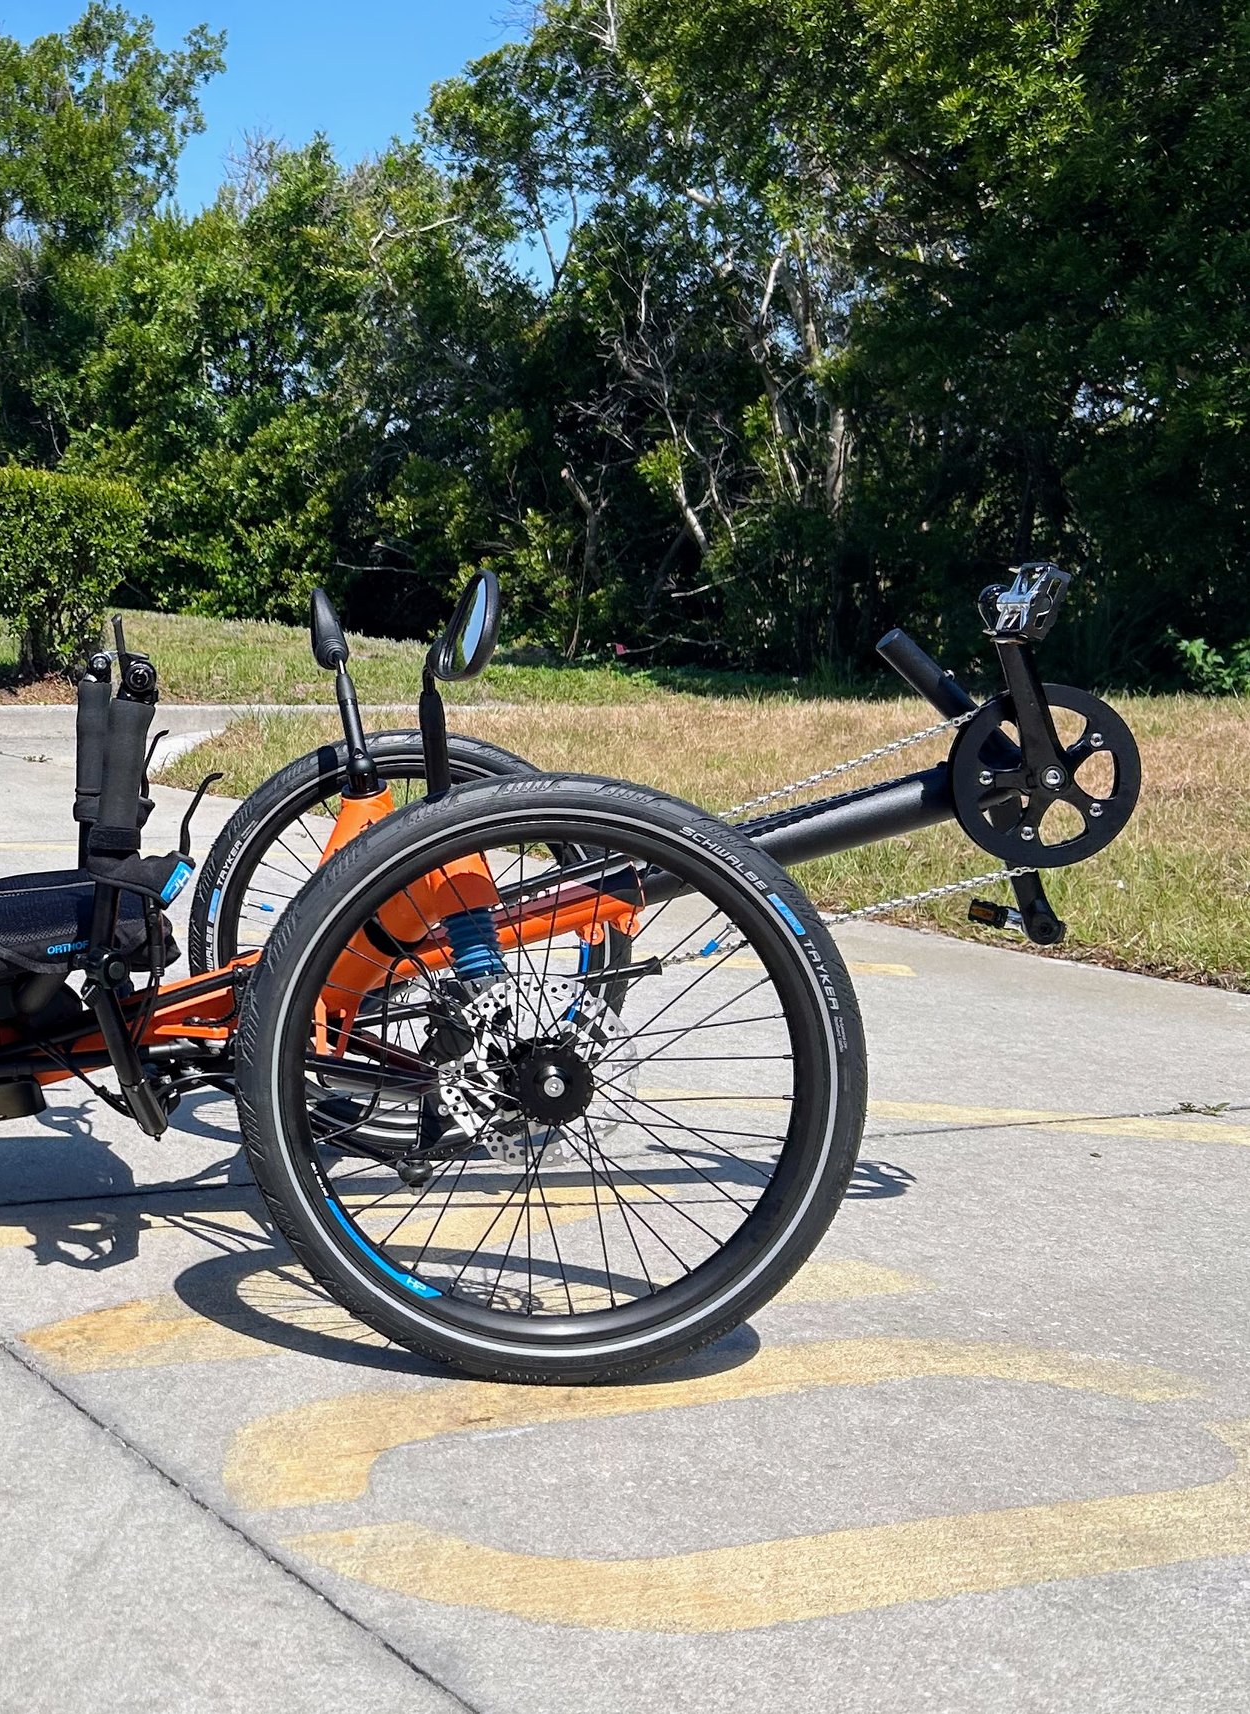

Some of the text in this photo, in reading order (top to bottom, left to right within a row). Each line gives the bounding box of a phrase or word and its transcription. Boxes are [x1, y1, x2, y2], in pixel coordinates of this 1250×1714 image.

[216, 840, 243, 887] TRYKER
[678, 825, 769, 892] SCHWALBE
[803, 938, 840, 1011] TRYKER
[406, 1276, 427, 1292] HP
